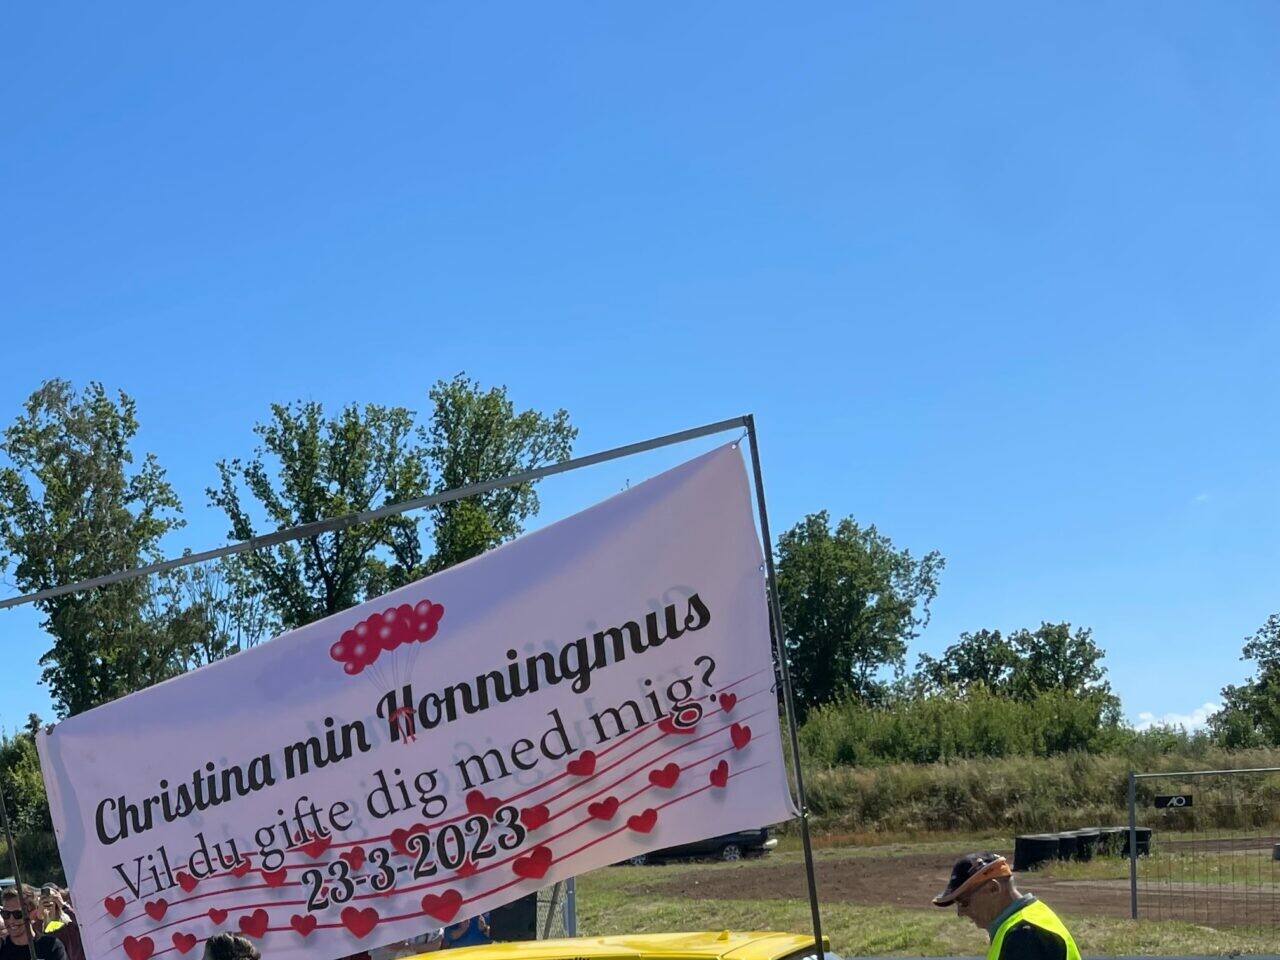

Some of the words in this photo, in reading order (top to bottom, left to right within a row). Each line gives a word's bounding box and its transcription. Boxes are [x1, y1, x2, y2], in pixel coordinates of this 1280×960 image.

[95, 754, 275, 845] Christina
[284, 717, 371, 779] min
[376, 593, 711, 742] Honningmus
[112, 846, 179, 899] Vil
[188, 832, 246, 879] du
[255, 796, 354, 871] gifte
[366, 768, 448, 819] dig
[455, 708, 577, 791] med
[589, 656, 717, 744] mig?
[301, 806, 526, 912] 23-3-2023
